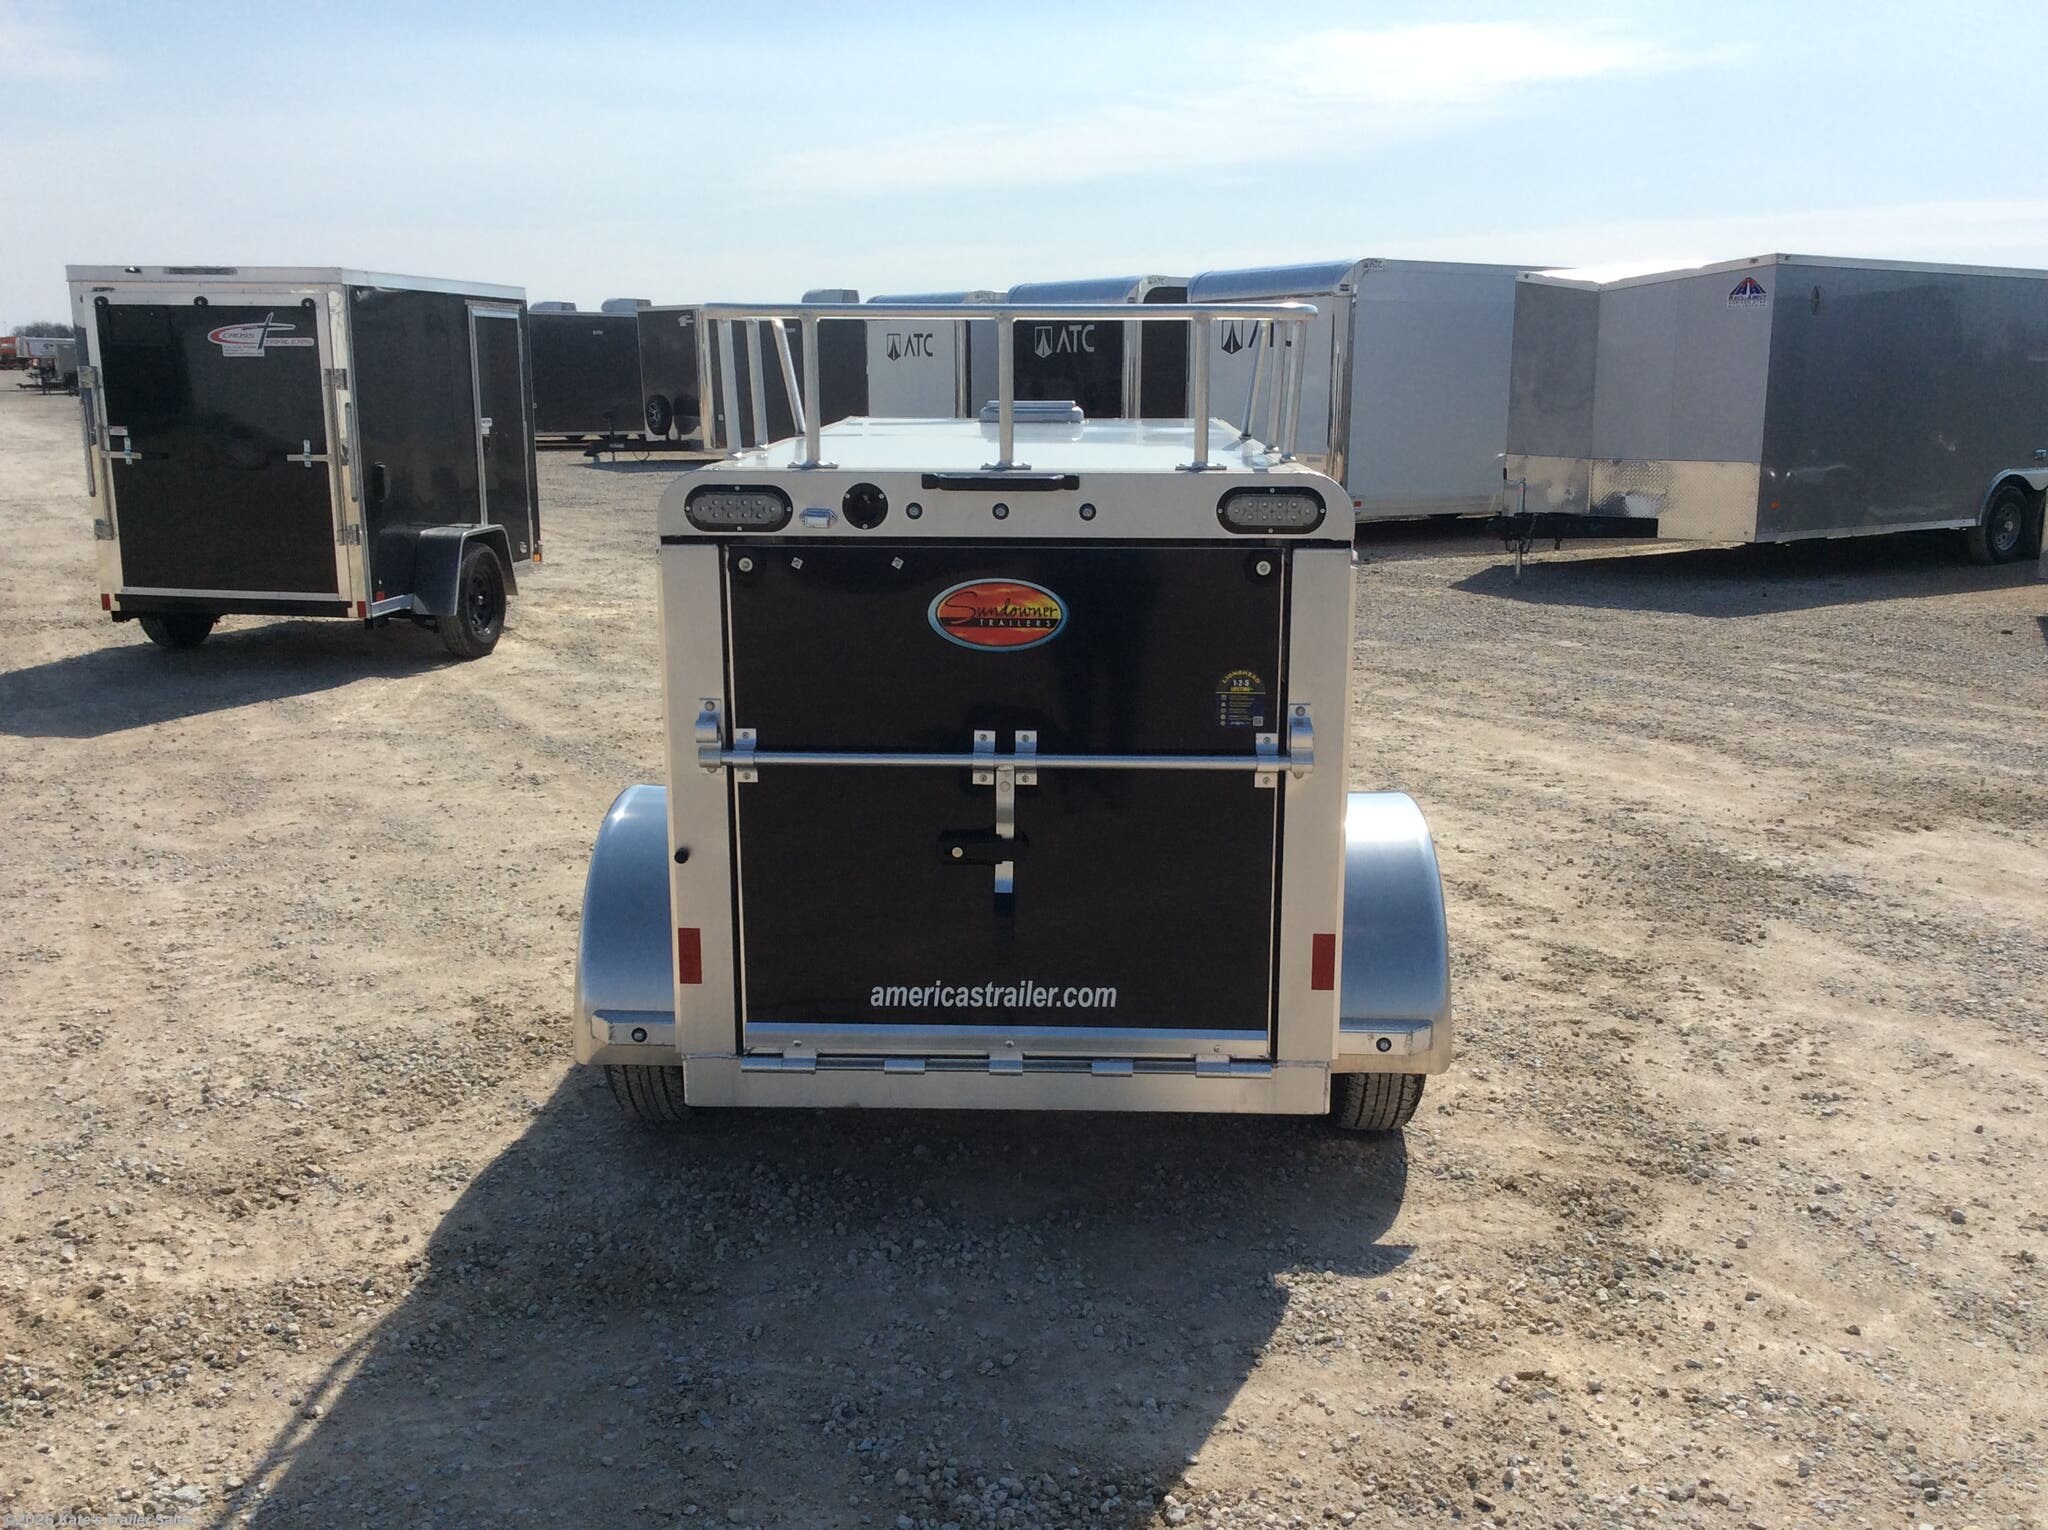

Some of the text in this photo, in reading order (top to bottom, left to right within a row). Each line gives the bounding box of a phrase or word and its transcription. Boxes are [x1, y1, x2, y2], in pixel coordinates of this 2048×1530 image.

[904, 333, 933, 357] ATC
[1056, 324, 1095, 353] ATC
[945, 591, 1058, 624] Sundowner
[979, 618, 1051, 627] TRAILERS
[870, 980, 1117, 1008] americastrailer.com
